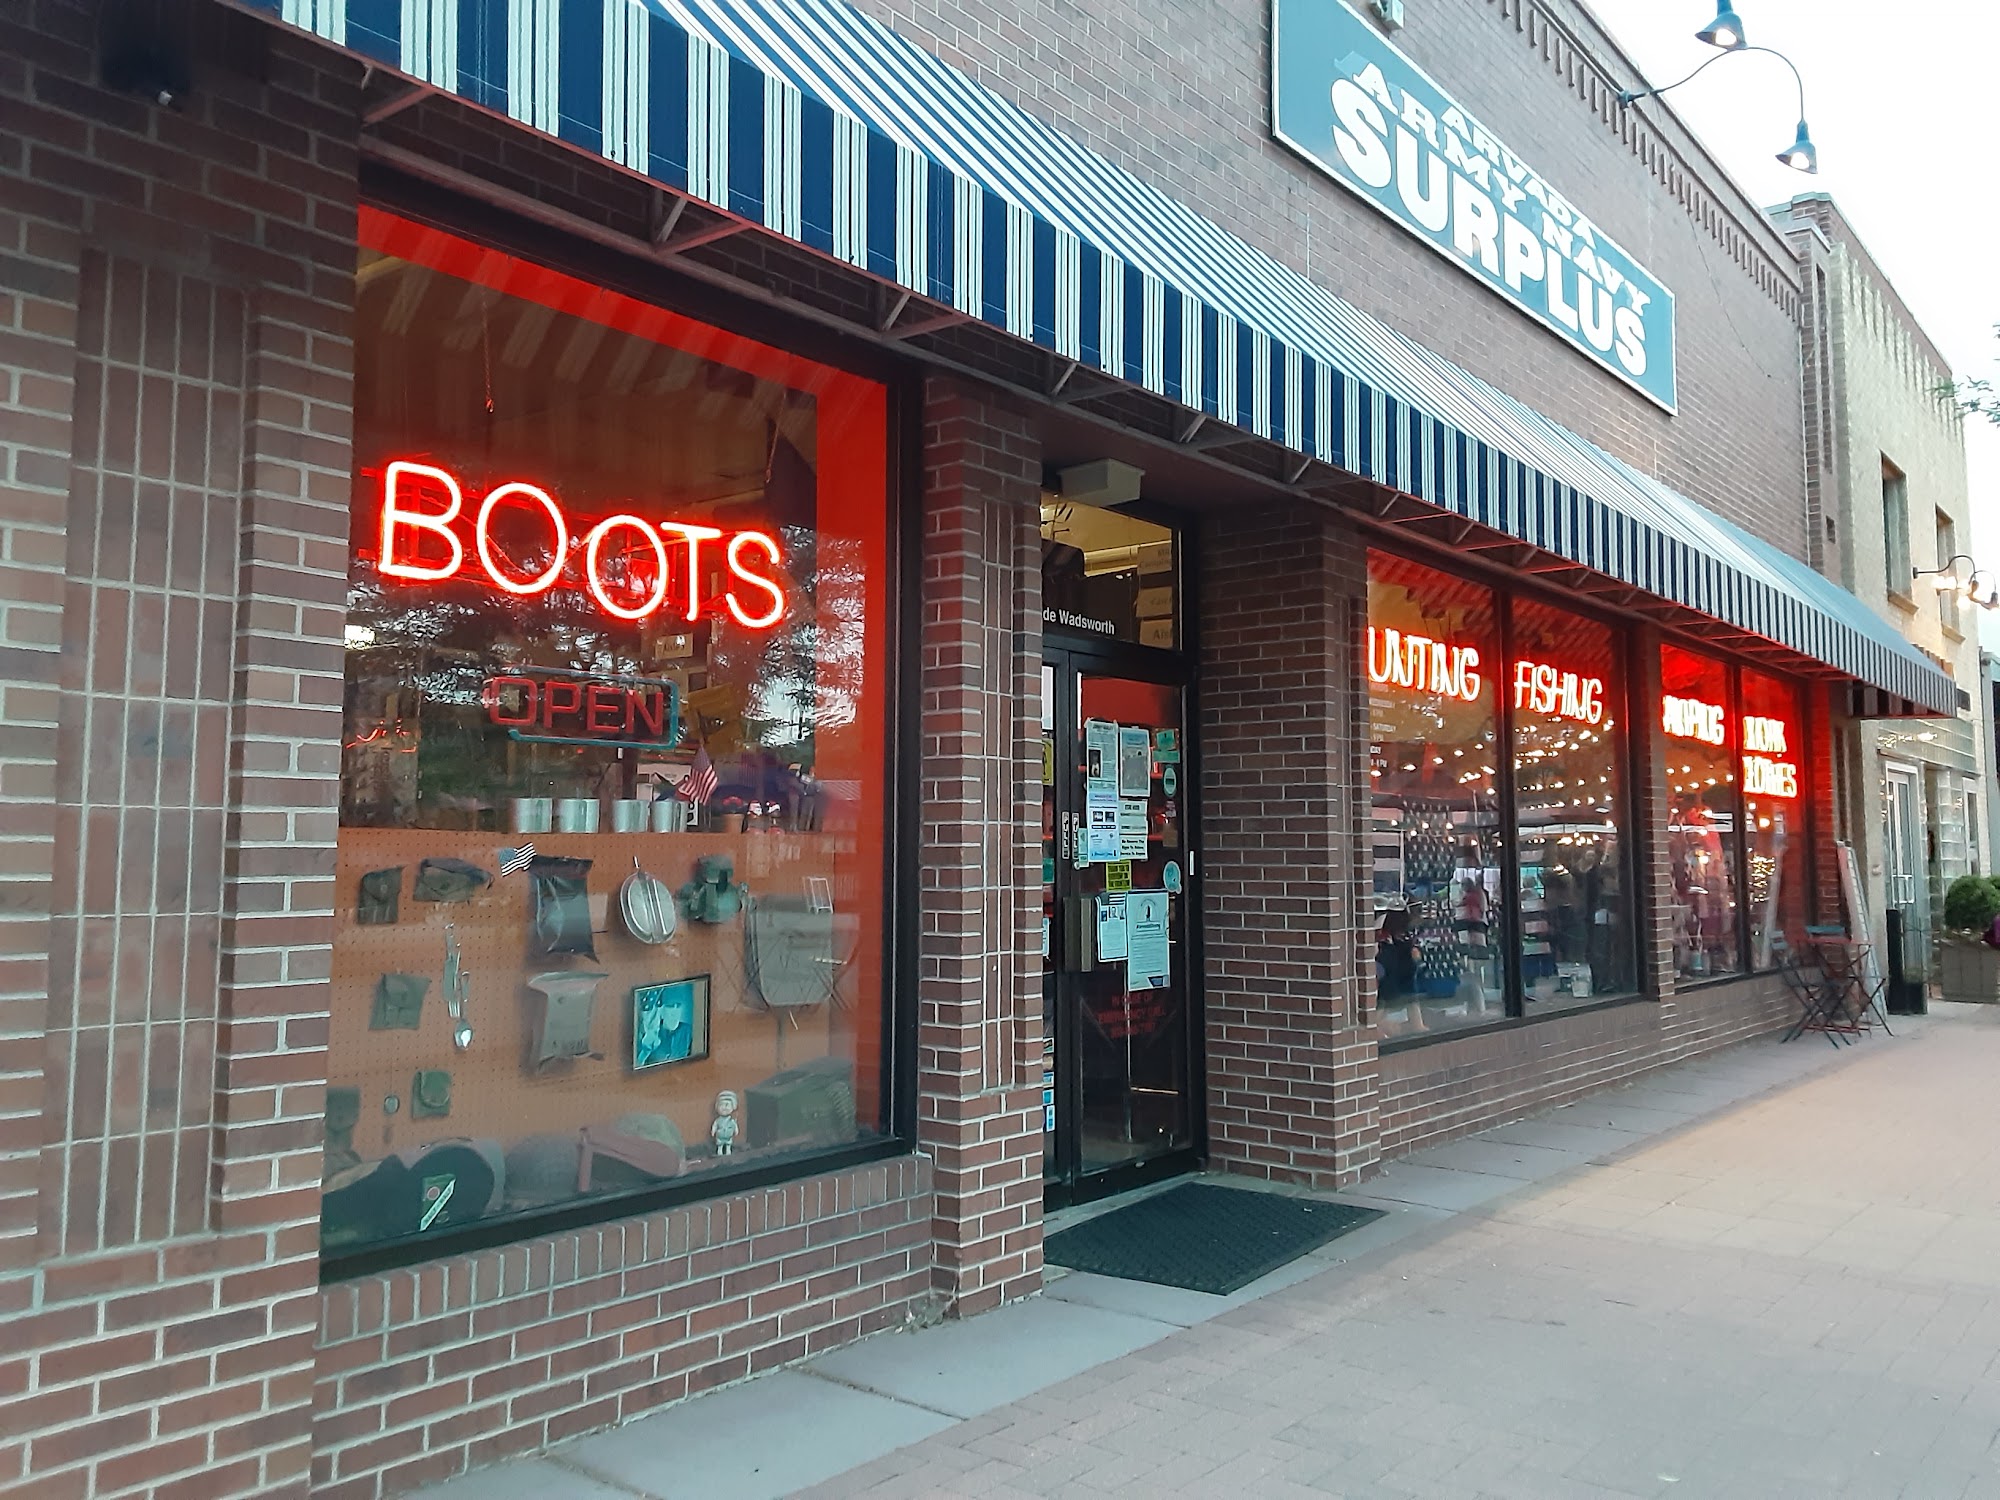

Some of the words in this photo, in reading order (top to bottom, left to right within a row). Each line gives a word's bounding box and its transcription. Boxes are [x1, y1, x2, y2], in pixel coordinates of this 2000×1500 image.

[1330, 77, 1648, 377] SURPLUS
[1352, 62, 1527, 214] ARMY
[1541, 210, 1652, 317] NAVY
[1441, 106, 1597, 250] ARVADA
[378, 461, 787, 628] BOOTS
[1058, 608, 1115, 635] Wadsworth
[1513, 660, 1603, 725] FISHING
[489, 676, 664, 736] OPEN
